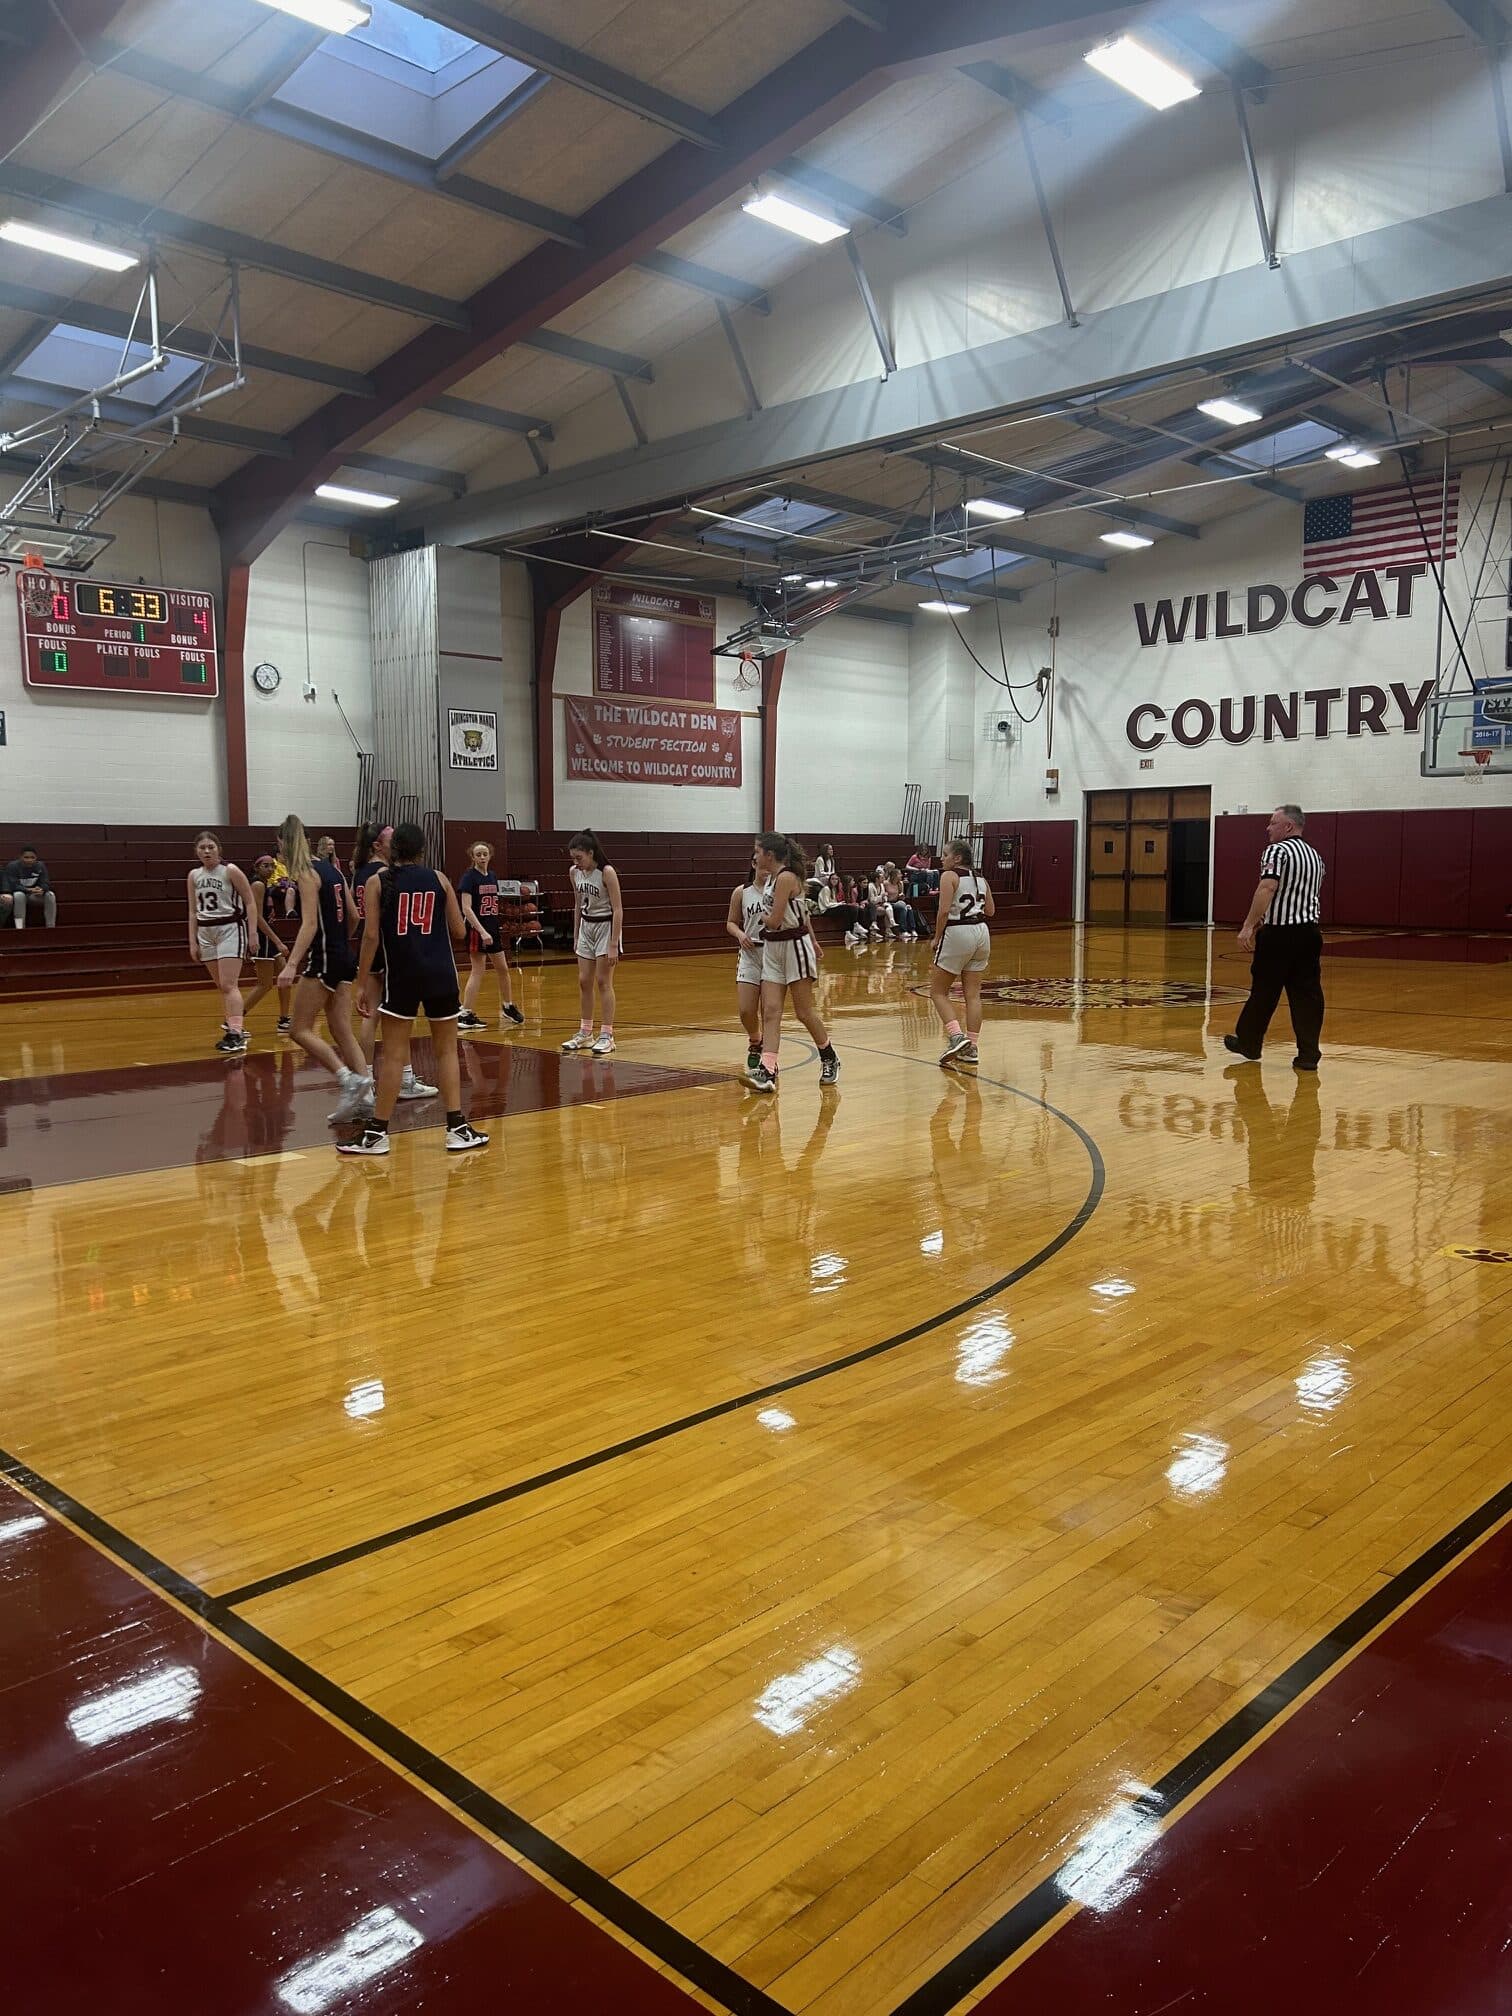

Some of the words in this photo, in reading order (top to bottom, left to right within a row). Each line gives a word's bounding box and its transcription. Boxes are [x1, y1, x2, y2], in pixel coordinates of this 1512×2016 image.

[27, 576, 70, 593] HOME
[53, 594, 68, 620] 0
[98, 588, 160, 620] 6:33
[169, 592, 210, 609] VISITOR
[1133, 562, 1428, 648] WILDCAT
[46, 622, 77, 635] BONUS
[193, 611, 208, 634] 4
[104, 629, 132, 640] PERIOD
[170, 634, 198, 646] BONUS
[38, 638, 67, 651] FOULS
[97, 644, 129, 657] PLAYER
[134, 648, 161, 659] FOULS
[55, 652, 67, 672] 0
[180, 651, 206, 662] FOULS
[594, 705, 622, 723] THE
[626, 707, 687, 728] WILDCAT
[691, 713, 717, 731] DEN
[1126, 680, 1436, 751] COUNTRY
[606, 734, 659, 750] STUDENT
[660, 738, 707, 753] SECTION
[452, 752, 495, 768] ATHLETICS
[571, 757, 624, 775] WELCOME
[627, 761, 641, 775] TO
[644, 762, 689, 777] WILDCAT
[691, 764, 737, 779] COUNTRY
[198, 892, 218, 911] 13
[480, 895, 499, 916] 25
[397, 891, 435, 935] 14
